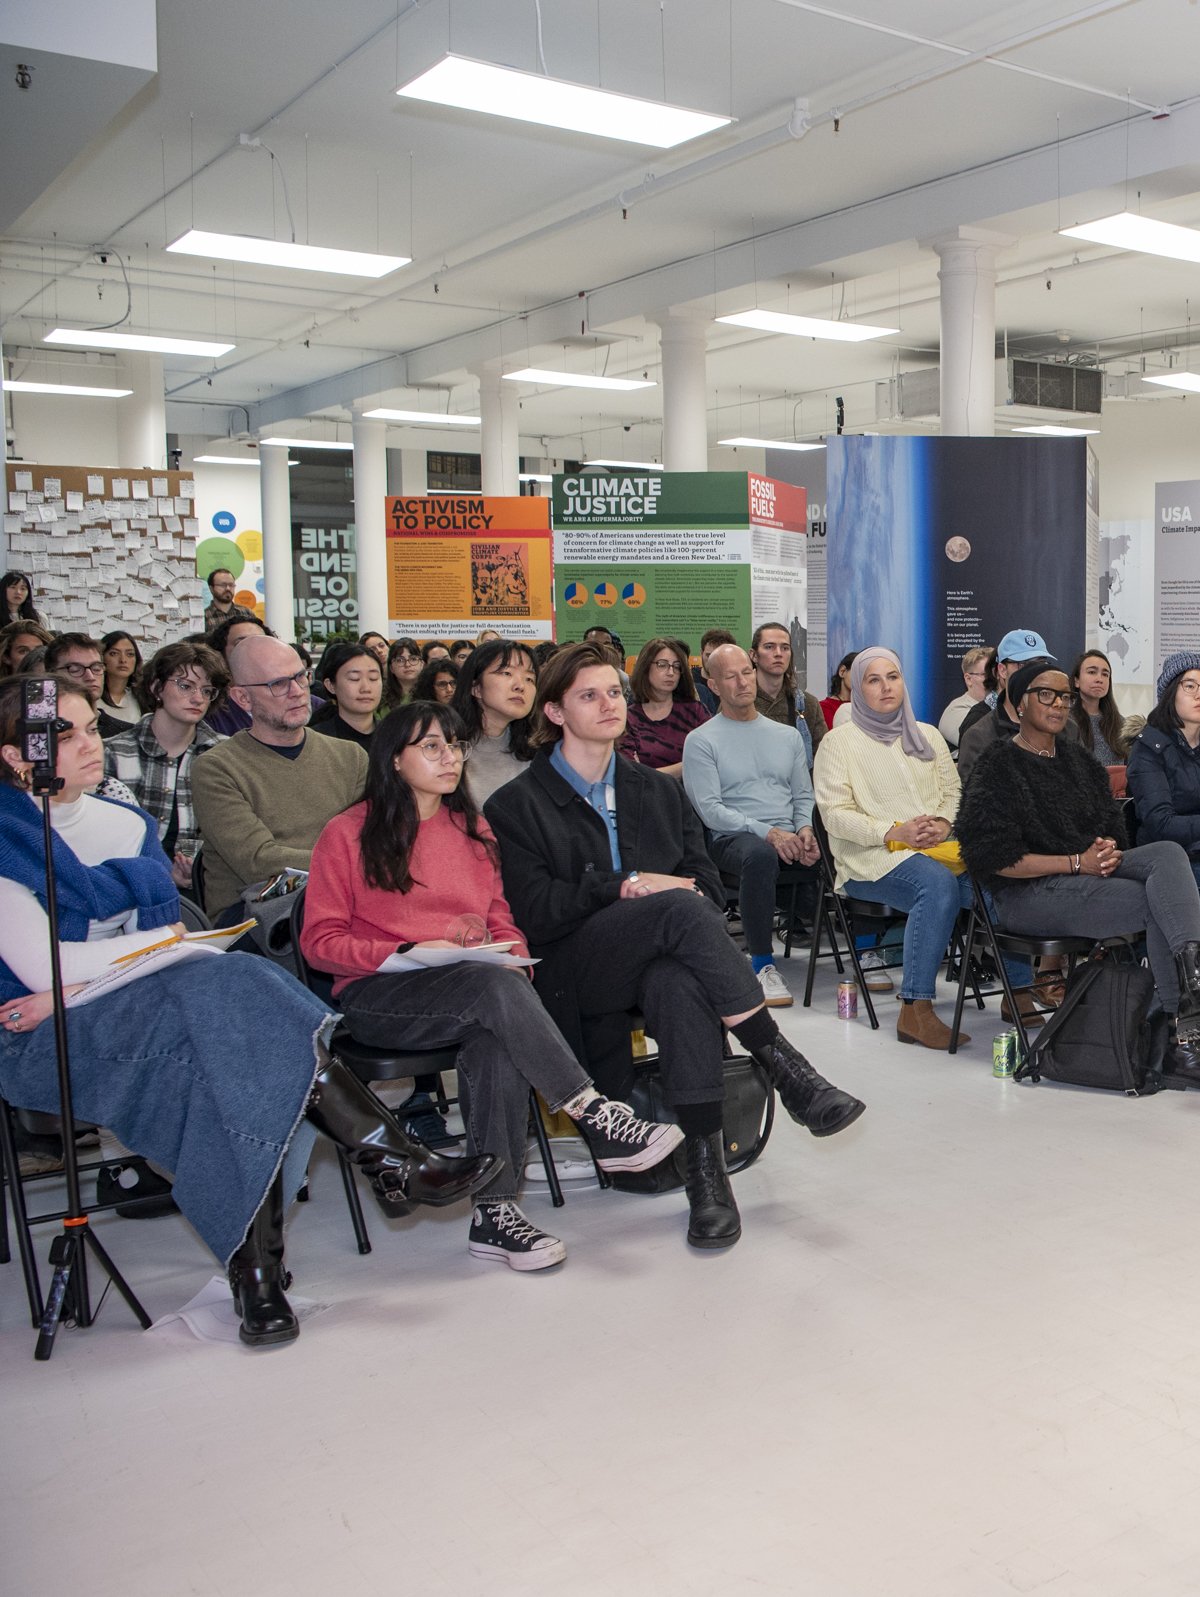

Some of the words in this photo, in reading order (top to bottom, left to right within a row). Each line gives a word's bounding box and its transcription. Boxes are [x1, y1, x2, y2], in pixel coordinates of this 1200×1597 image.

[562, 478, 661, 496] CLIMATE
[750, 478, 776, 501] FOSSIL
[392, 500, 484, 514] ACTIVISM
[562, 496, 657, 515] JUSTICE
[751, 497, 774, 519] FUELS
[1161, 506, 1192, 522] USA
[392, 515, 418, 529] TO
[424, 515, 494, 529] POLICY
[634, 539, 656, 547] change
